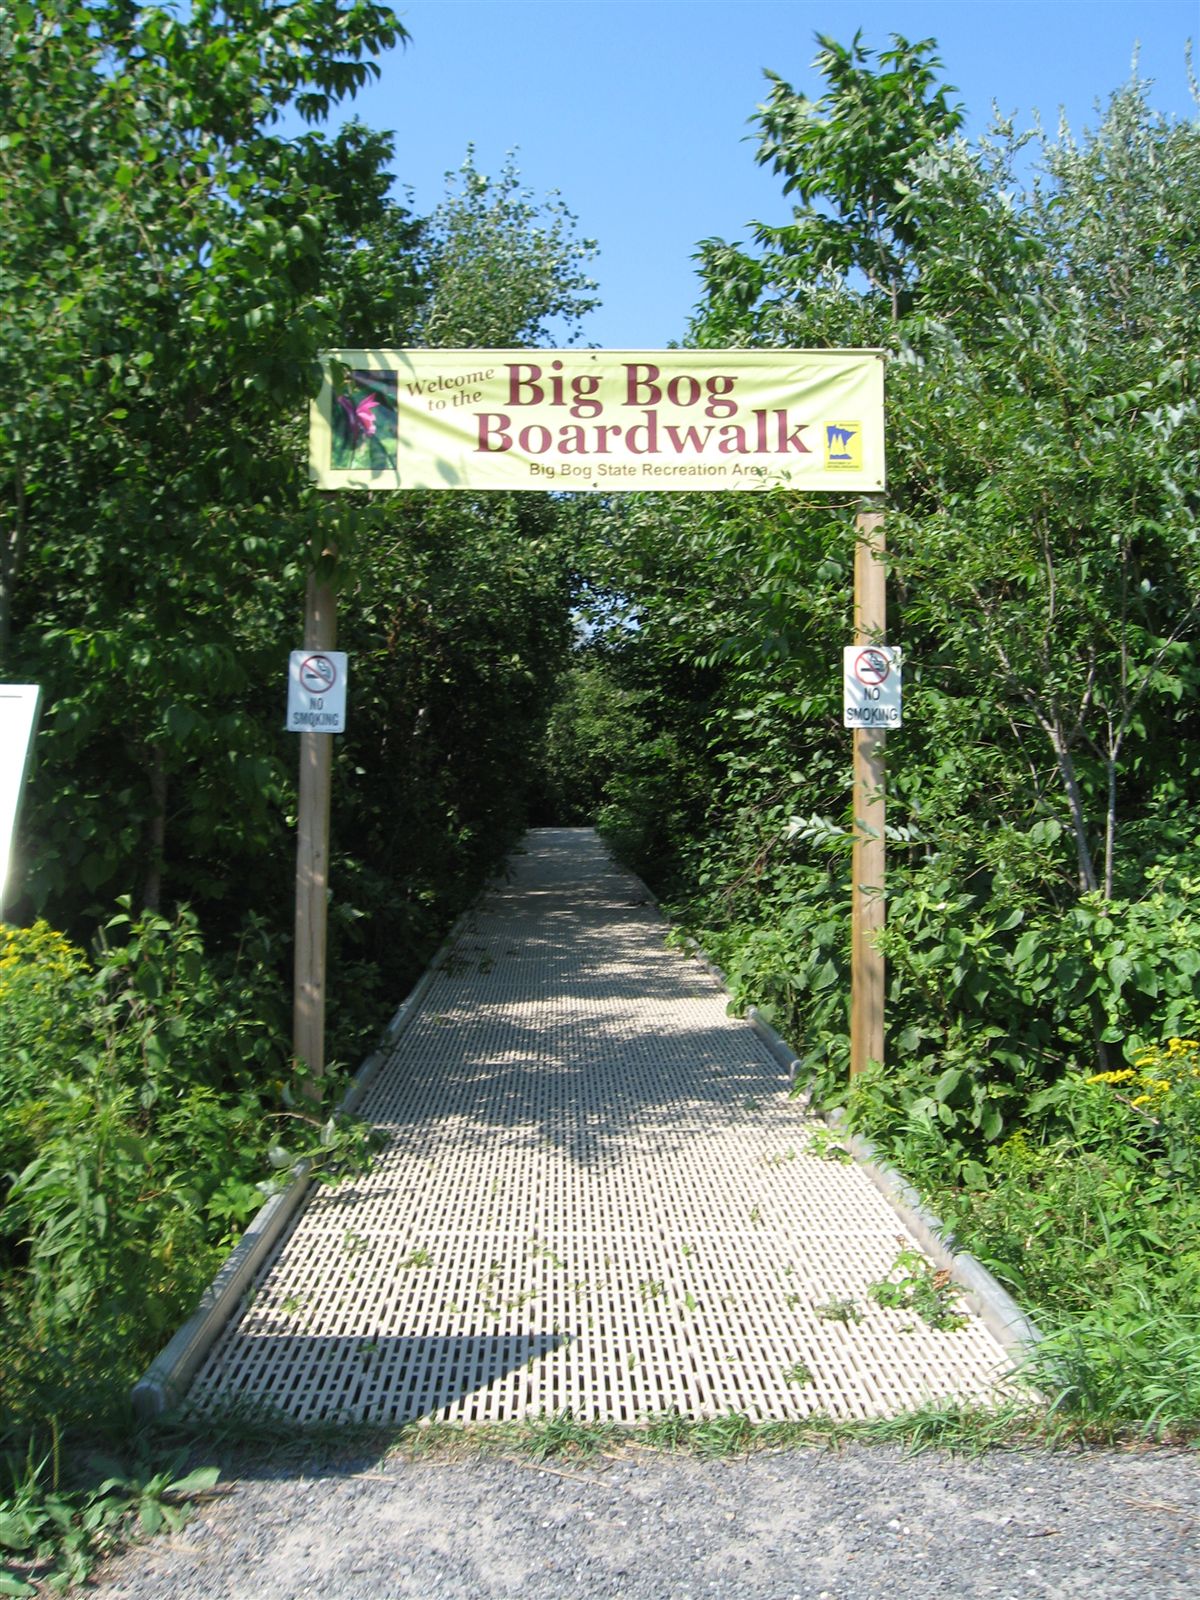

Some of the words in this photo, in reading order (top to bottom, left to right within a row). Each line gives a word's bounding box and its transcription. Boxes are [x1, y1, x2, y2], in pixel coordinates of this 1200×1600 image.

[406, 368, 495, 397] Welcome
[503, 360, 604, 419] Big
[621, 363, 738, 419] Bog
[428, 399, 446, 411] to
[452, 390, 482, 408] the
[472, 409, 812, 455] Boardwalk
[529, 463, 555, 478] Big
[560, 463, 592, 479] Bog
[597, 463, 637, 476] State
[643, 463, 727, 476] Recreation
[731, 463, 768, 476] Area
[864, 687, 881, 701] NO
[309, 697, 324, 711] NO
[293, 712, 339, 726] SMOKING
[846, 707, 898, 721] SMOKING
